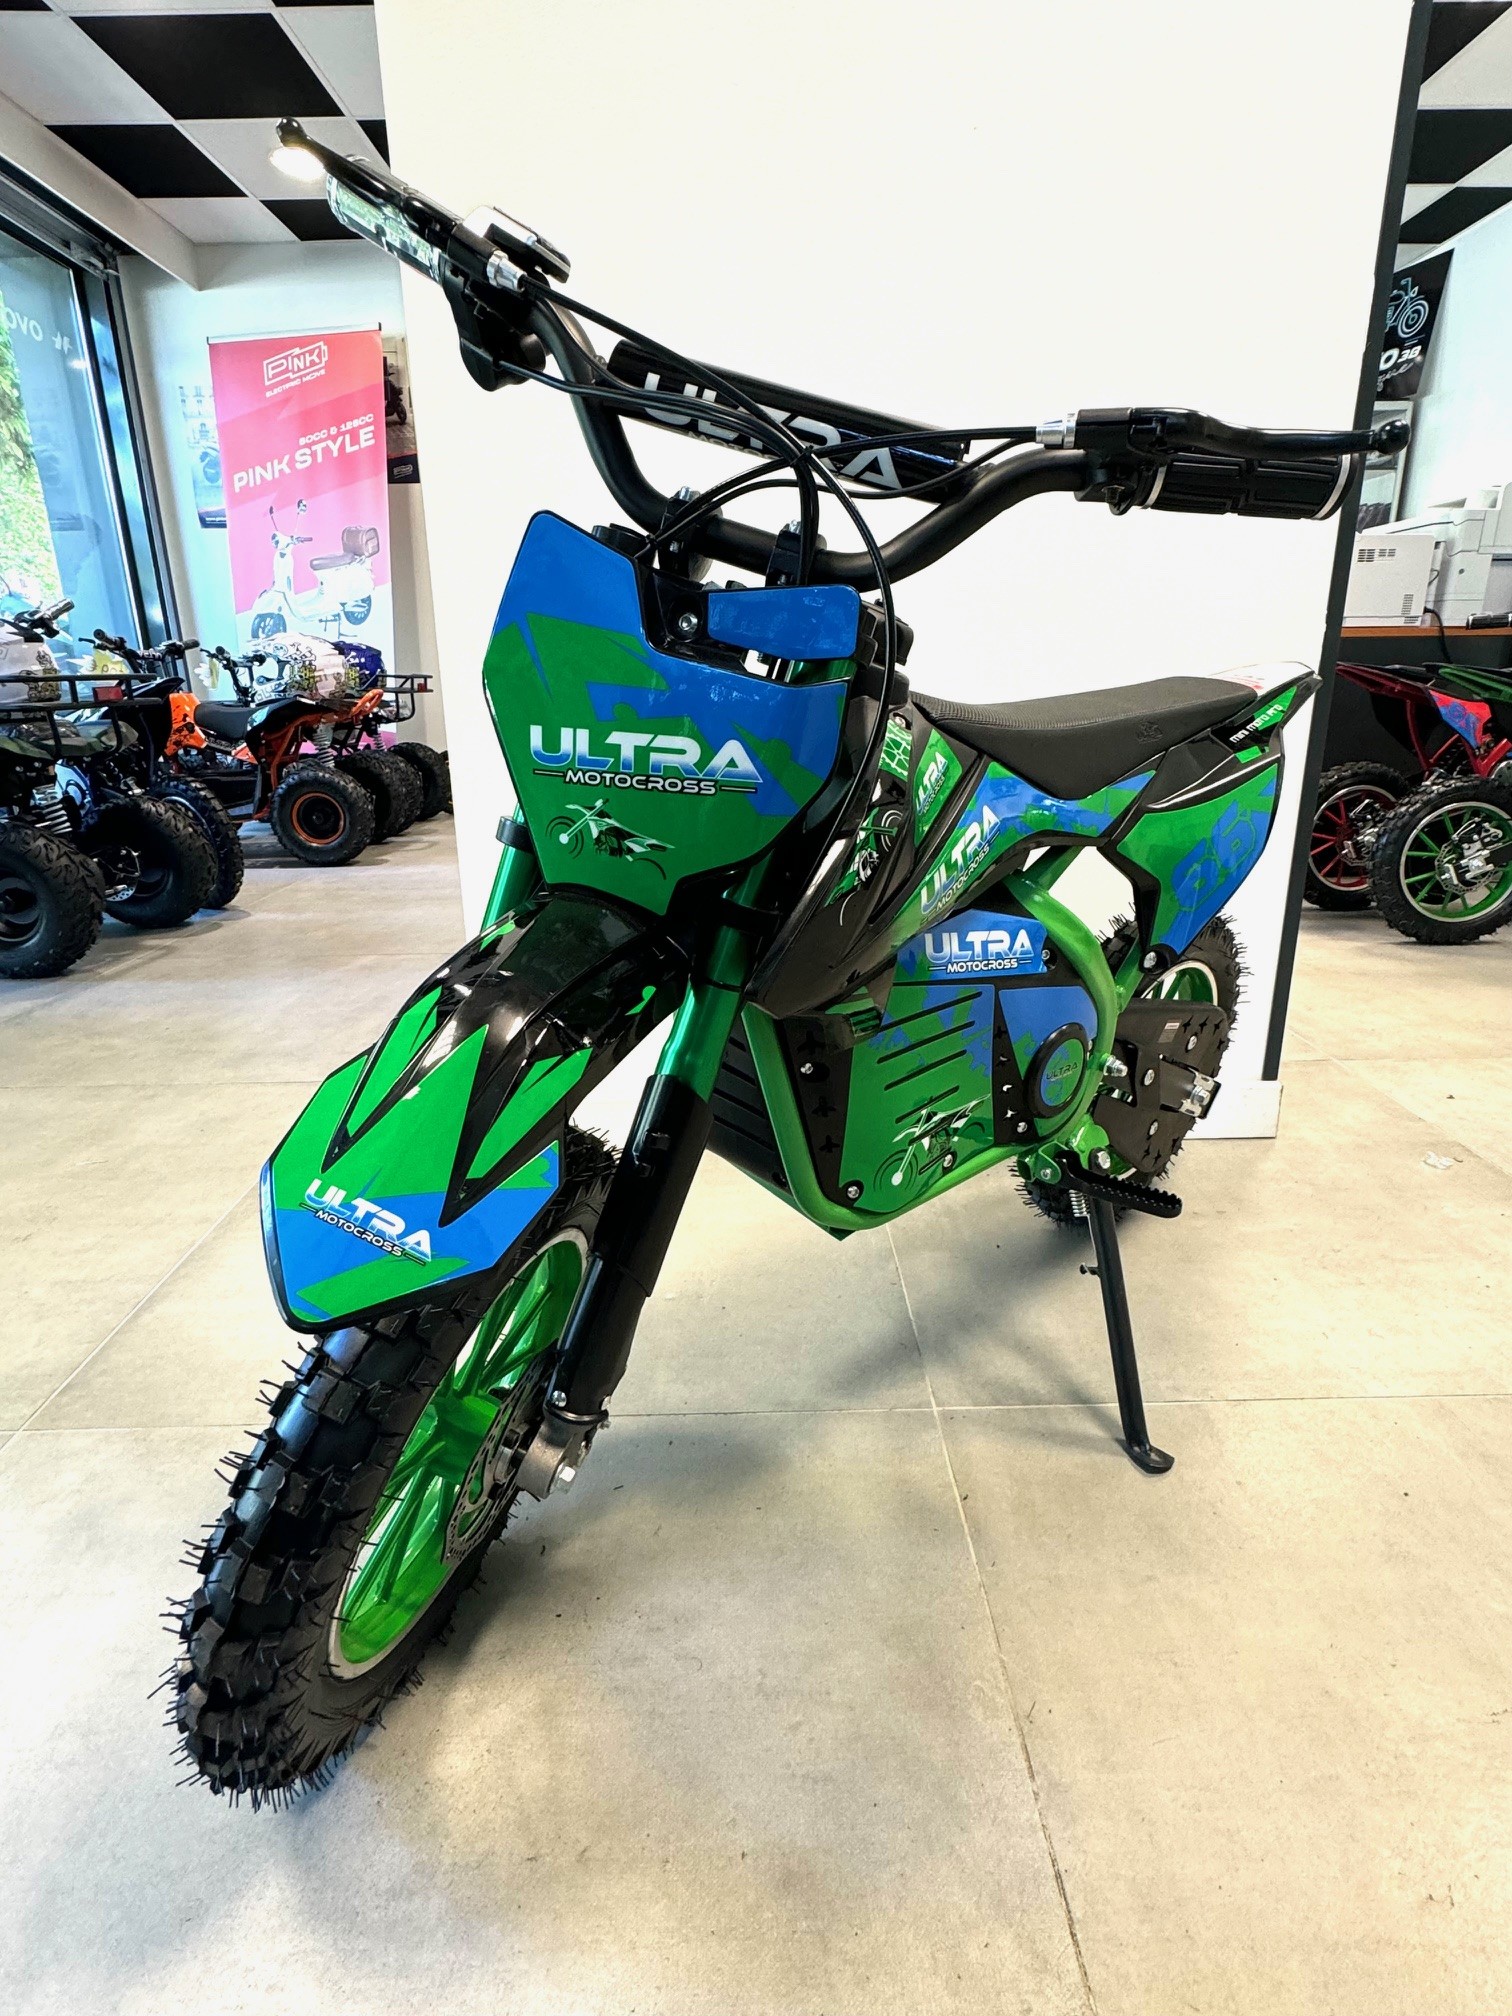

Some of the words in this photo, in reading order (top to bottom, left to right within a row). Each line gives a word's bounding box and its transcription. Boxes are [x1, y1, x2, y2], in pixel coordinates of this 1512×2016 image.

[265, 378, 302, 398] ELECTRIC
[302, 368, 326, 383] MOVE
[266, 346, 322, 381] PINK
[233, 454, 291, 494] PINK
[294, 425, 376, 470] STYLE
[530, 724, 764, 783] ULTRA
[565, 769, 717, 795] MOTOCROSS
[916, 751, 949, 816] ULTRA
[920, 804, 1001, 915] ULTRA
[936, 845, 991, 911] MOTOCROSS
[924, 928, 1035, 964] ULTRA
[946, 958, 1019, 974] MOTOCROSS
[1046, 1061, 1078, 1080] ULTRA
[304, 1178, 432, 1262] ULTRA
[315, 1209, 404, 1257] MOTOCROSS
